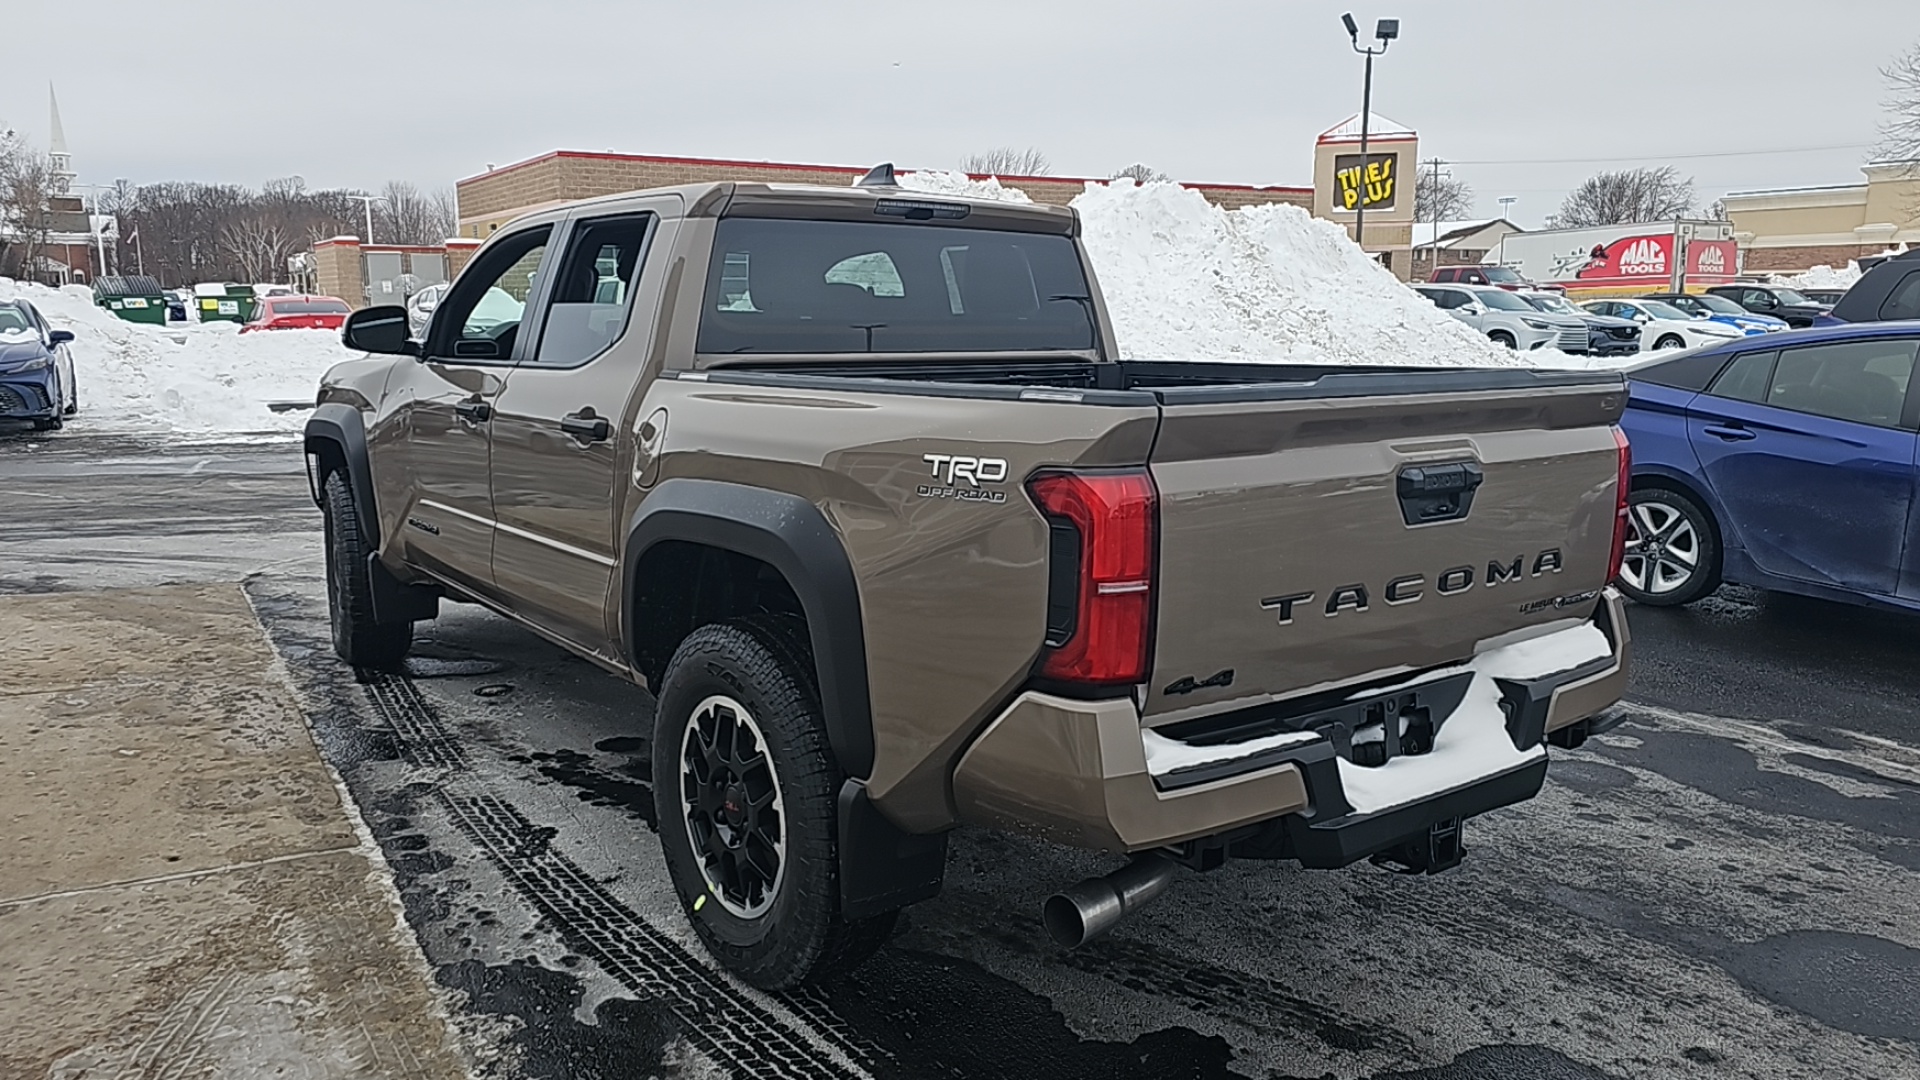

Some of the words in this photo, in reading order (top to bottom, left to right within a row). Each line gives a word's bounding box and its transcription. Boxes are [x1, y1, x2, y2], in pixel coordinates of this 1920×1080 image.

[1337, 158, 1392, 191] TIRES
[1620, 239, 1666, 265] MAC
[1698, 245, 1725, 265] MAC
[1619, 263, 1666, 275] TOOLS
[1698, 264, 1725, 273] TOOLS
[922, 453, 1008, 488] TRD
[917, 484, 953, 498] OFF
[954, 488, 1007, 503] ROAD
[1260, 548, 1564, 625] TACOMA
